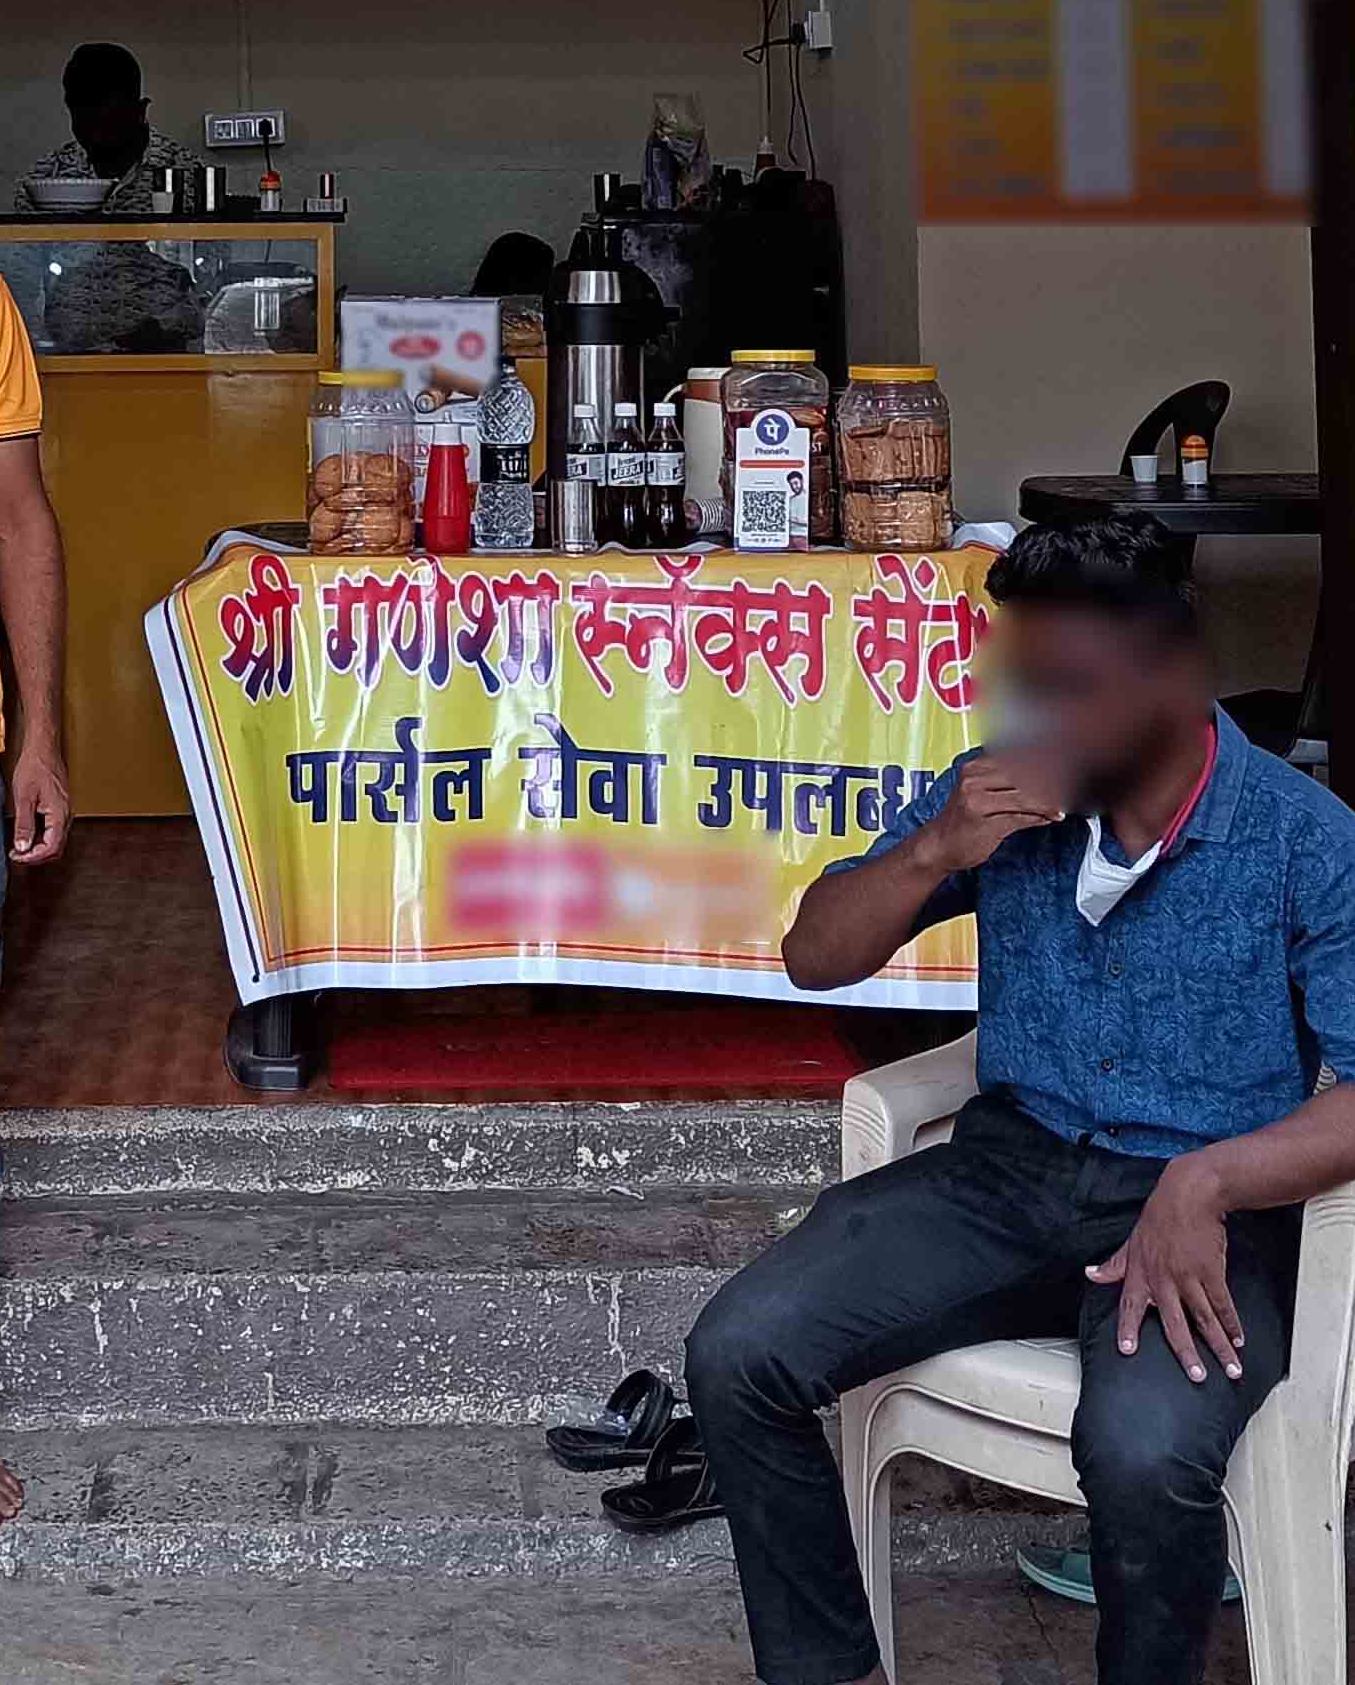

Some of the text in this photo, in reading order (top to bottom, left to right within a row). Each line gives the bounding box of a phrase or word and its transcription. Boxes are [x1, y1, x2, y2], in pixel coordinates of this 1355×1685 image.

[220, 553, 988, 713] श्री गणेशा स्नॅक्स सेंट
[286, 716, 492, 823] पार्सल
[518, 713, 667, 824] सेवा
